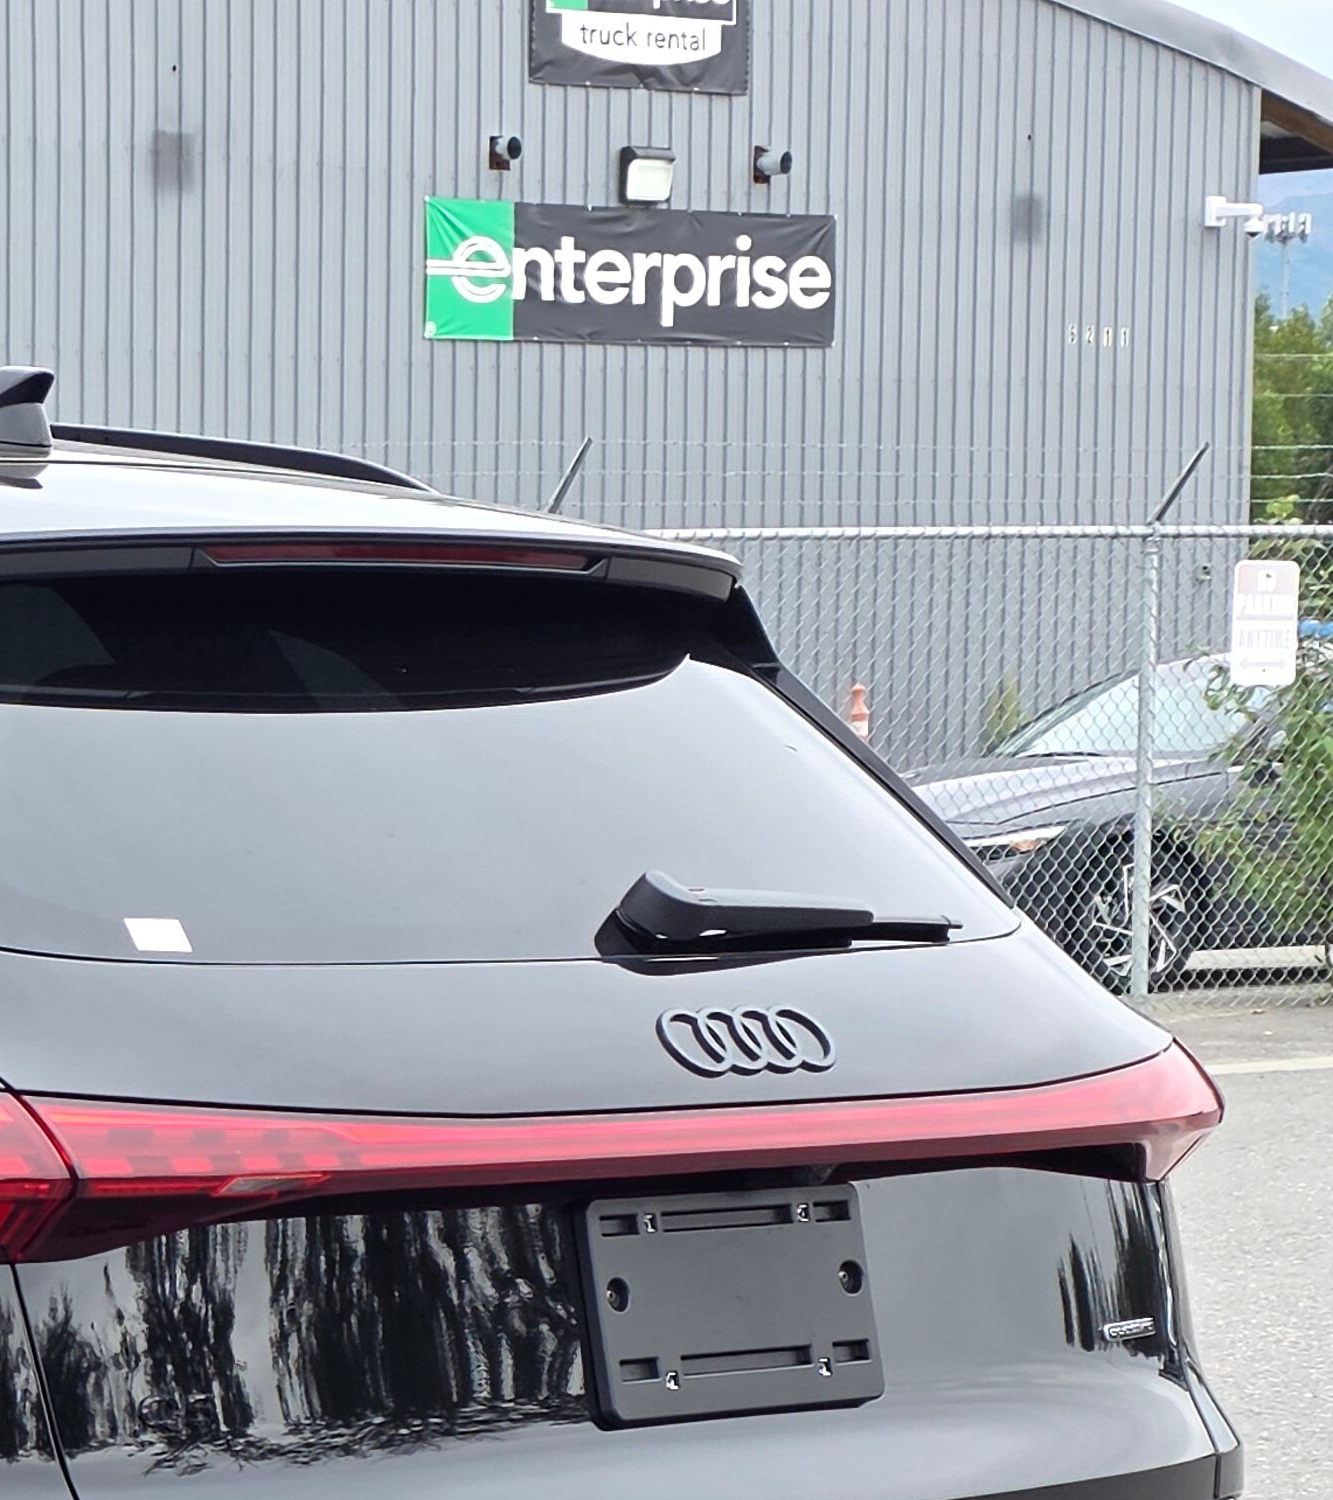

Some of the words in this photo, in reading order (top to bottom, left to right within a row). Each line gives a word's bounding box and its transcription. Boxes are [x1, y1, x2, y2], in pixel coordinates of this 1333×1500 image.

[580, 22, 638, 47] truck
[647, 27, 706, 51] rental
[426, 233, 832, 328] enterprise
